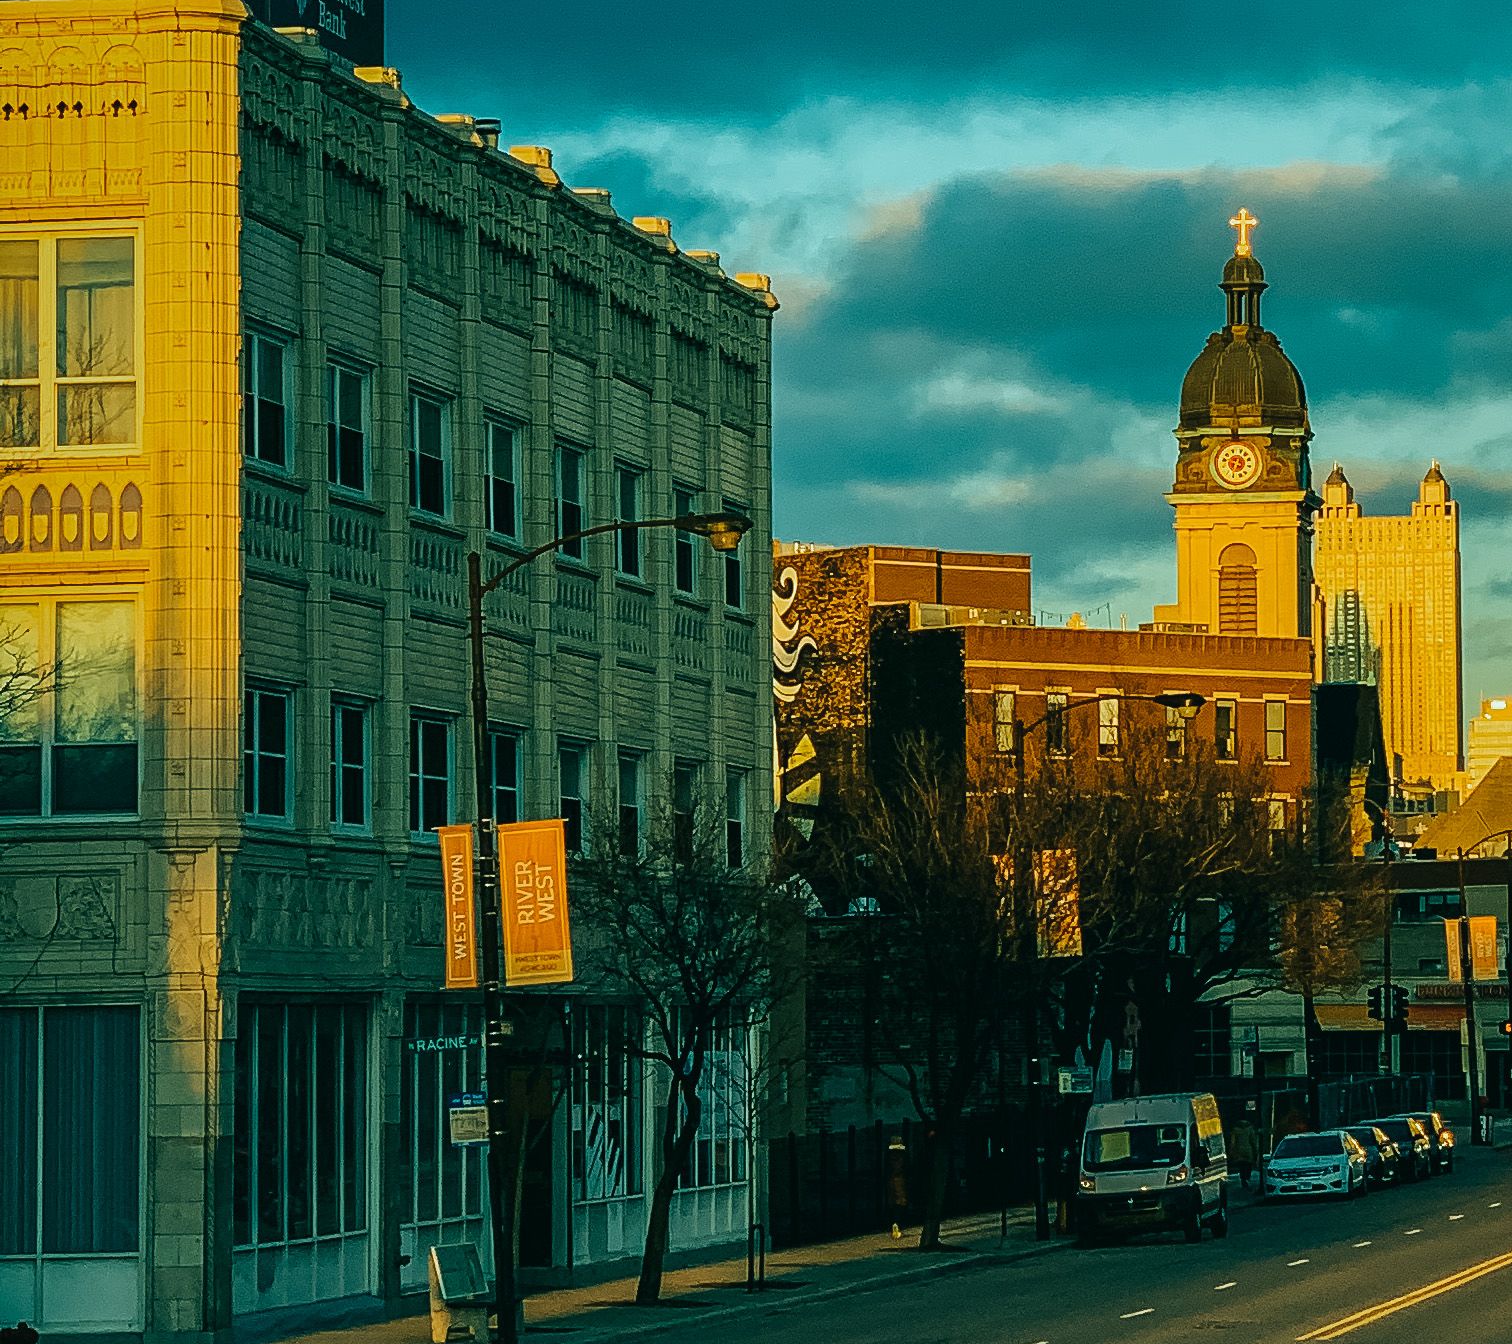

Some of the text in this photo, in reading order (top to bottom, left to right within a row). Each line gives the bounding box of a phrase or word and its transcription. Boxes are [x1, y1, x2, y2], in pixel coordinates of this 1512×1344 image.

[318, 0, 347, 40] Bank
[451, 854, 467, 960] WEST TOWN
[515, 860, 535, 926] RIVER
[535, 862, 557, 924] WEST
[416, 1036, 468, 1052] RACINE
